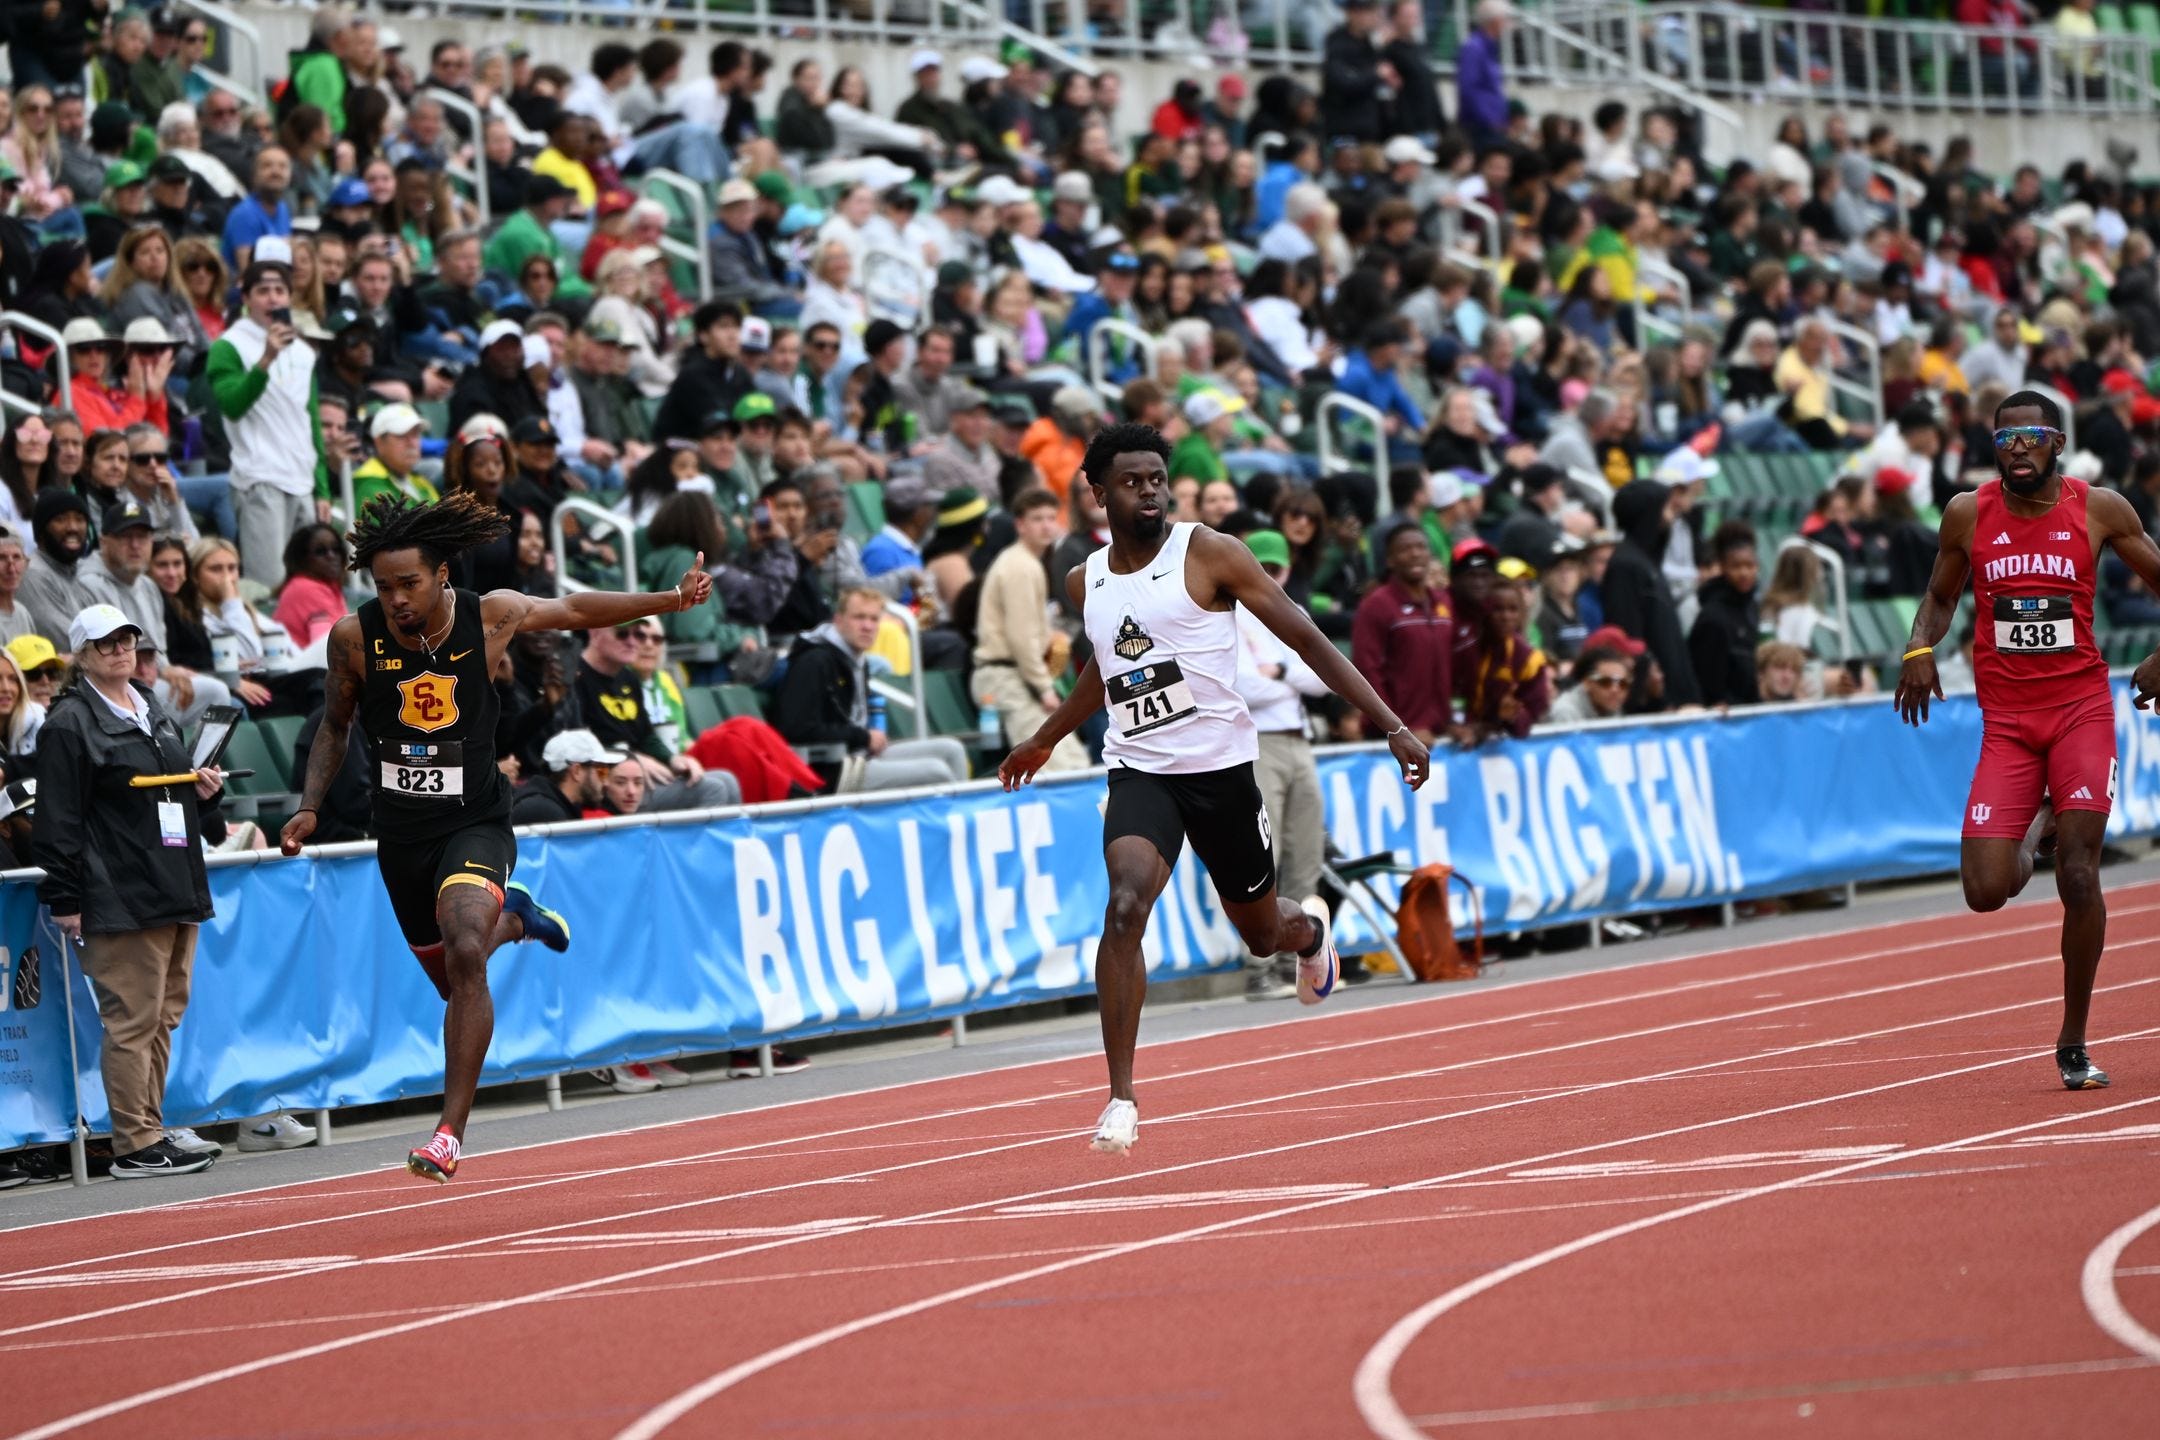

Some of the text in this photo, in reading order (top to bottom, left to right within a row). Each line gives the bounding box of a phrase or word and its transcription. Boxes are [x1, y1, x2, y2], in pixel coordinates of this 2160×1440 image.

[1984, 553, 2077, 582] INDIANA
[374, 638, 385, 654] C
[1116, 638, 1152, 656] PURDUE
[2009, 623, 2057, 648] 438
[1125, 690, 1174, 726] 741
[397, 767, 445, 793] 823
[733, 823, 898, 1034] BIG
[899, 802, 1099, 1008] LIFE.
[1479, 746, 1609, 920] BIG
[1597, 735, 1744, 900] TEN.
